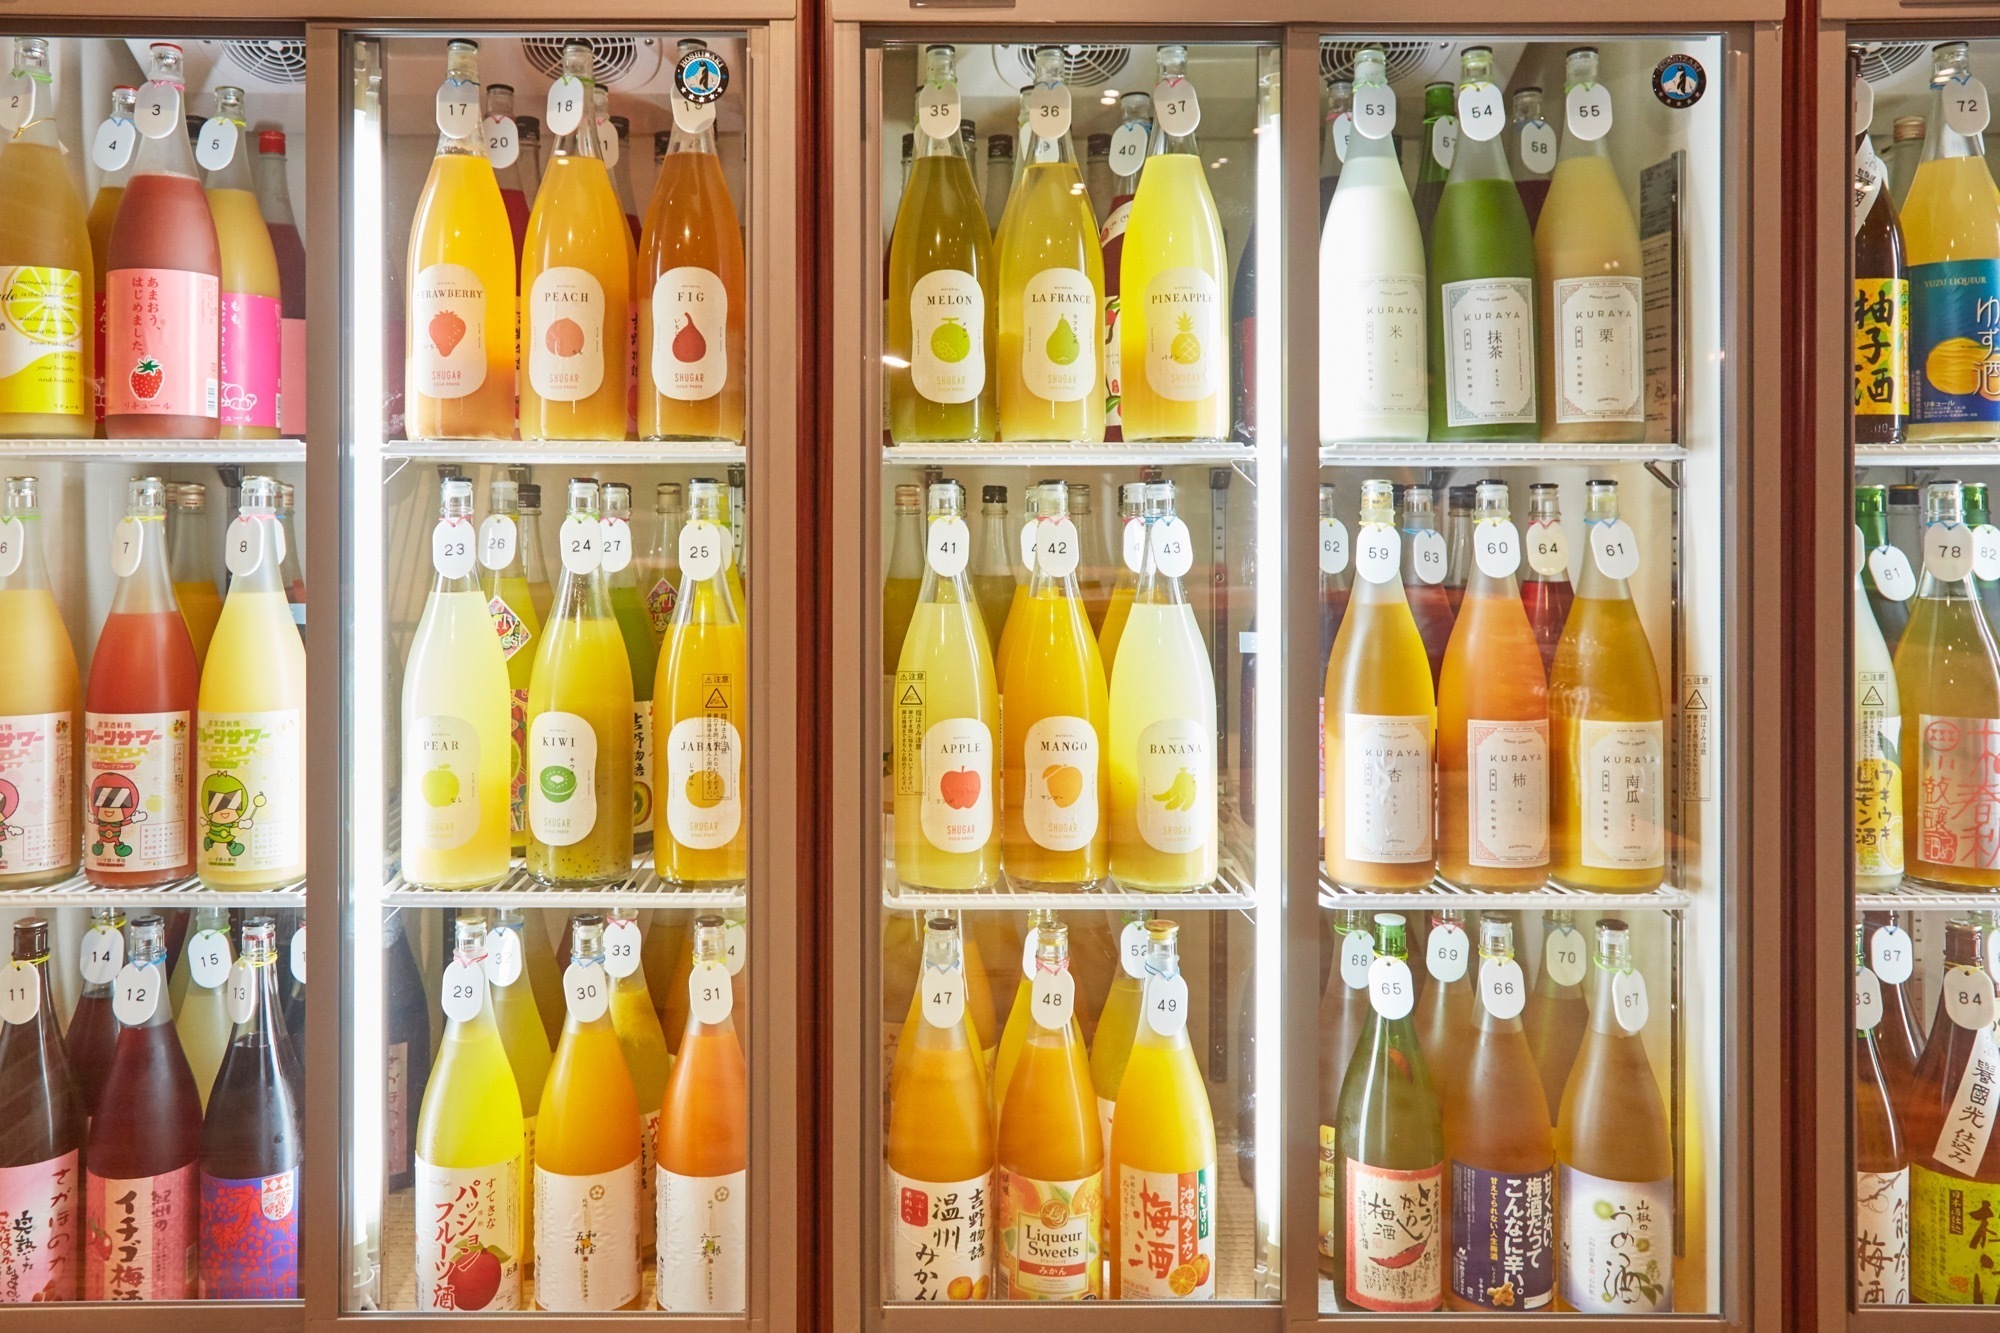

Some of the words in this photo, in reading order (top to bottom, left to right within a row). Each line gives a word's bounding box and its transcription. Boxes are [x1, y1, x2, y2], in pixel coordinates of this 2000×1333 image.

[11, 97, 18, 107] 2
[556, 100, 573, 113] 18
[1167, 101, 1187, 115] 37
[1956, 100, 1977, 112] 72
[152, 104, 160, 116] 3
[448, 103, 467, 116] 17
[930, 105, 949, 117] 35
[1040, 106, 1059, 117] 36
[1366, 104, 1385, 116] 53
[1472, 106, 1493, 119] 54
[1579, 105, 1600, 117] 55
[109, 140, 117, 150] 4
[211, 139, 219, 150] 5
[490, 137, 508, 149] 20
[1532, 141, 1547, 154] 58
[1119, 145, 1136, 156] 40
[1924, 278, 1947, 288] YUZU
[1949, 276, 1987, 286] LIQUEUR
[417, 290, 484, 299] TRAWBERRY
[545, 292, 589, 303] PEACH
[677, 291, 704, 302] FIG
[927, 294, 973, 306] MELON
[1032, 293, 1047, 303] LA
[1050, 292, 1091, 305] FRANCE
[132, 277, 144, 355] はじめました。
[1367, 306, 1418, 315] KURAYA
[1464, 311, 1520, 322] KURAYA
[1575, 310, 1632, 319] KURAYA
[1389, 325, 1403, 339] 米
[1599, 328, 1614, 342] 栗
[1487, 330, 1503, 360] 抹茶
[432, 370, 462, 381] SHUGAR
[549, 373, 579, 384] SHUGAR
[674, 373, 704, 383] SHUGAR
[936, 376, 966, 385] SHUGAR
[1048, 374, 1077, 384] SHUGAR
[0, 542, 7, 551] 6
[123, 542, 129, 554] 7
[239, 541, 247, 553] 8
[445, 543, 465, 556] 23
[488, 538, 505, 550] 26
[572, 539, 591, 552] 24
[604, 541, 621, 552] 27
[940, 542, 956, 554] 41
[1048, 542, 1067, 554] 42
[1163, 542, 1181, 555] 43
[1324, 541, 1340, 553] 62
[1487, 542, 1508, 554] 60
[1539, 543, 1558, 555] 64
[1606, 543, 1624, 556] 61
[690, 546, 709, 559] 25
[1369, 547, 1388, 560] 59
[1424, 551, 1439, 563] 63
[1938, 545, 1961, 558] 78
[1981, 547, 1996, 560] 82
[1884, 568, 1900, 580] 81
[713, 675, 729, 683] 注意
[908, 672, 924, 681] 注意
[1693, 676, 1710, 685] 注意
[1870, 673, 1886, 681] 注意
[424, 741, 459, 751] PEAR
[543, 737, 575, 747] KIWI
[941, 742, 981, 754] APPLE
[1041, 741, 1088, 752] MANGO
[1150, 743, 1202, 754] BANANA
[1366, 749, 1421, 757] KURAYA
[1490, 754, 1542, 762] KURAYA
[1603, 756, 1655, 764] KURAYA
[1388, 768, 1402, 783] 杏
[1512, 773, 1526, 788] 柿
[1626, 775, 1640, 804] 南瓜
[1855, 767, 1876, 846] レモン酒
[1875, 763, 1892, 841] ウキウキ
[544, 817, 571, 827] SHUGAR
[689, 822, 719, 831] SHUGAR
[1048, 822, 1077, 833] SHUGAR
[947, 825, 975, 835] SHUGAR
[1163, 826, 1192, 835] SHUGAR
[612, 945, 631, 956] 33
[1439, 948, 1457, 961] 69
[1884, 950, 1901, 961] 87
[92, 951, 110, 963] 14
[201, 954, 219, 967] 15
[1352, 954, 1367, 966] 68
[1558, 952, 1576, 964] 70
[9, 988, 25, 1000] 11
[127, 988, 146, 1002] 12
[233, 987, 246, 1000] 13
[453, 986, 473, 998] 29
[577, 986, 596, 1000] 30
[703, 988, 720, 1000] 31
[1381, 983, 1401, 995] 65
[1494, 983, 1513, 995] 66
[933, 992, 952, 1005] 47
[1043, 993, 1062, 1006] 48
[1624, 993, 1639, 1008] 67
[1959, 992, 1982, 1005] 84
[1157, 1000, 1177, 1012] 49
[486, 1178, 497, 1229] すてきな
[1198, 1183, 1208, 1235] 生しぼり
[1368, 1193, 1396, 1240] 梅酒
[1490, 1177, 1498, 1261] 甘えてられない人生梅酒
[1637, 1200, 1651, 1231] 山椒の
[455, 1179, 481, 1273] パッション
[968, 1188, 985, 1261] 吉野物語
[1128, 1177, 1179, 1279] 梅酒
[1180, 1184, 1196, 1260] 沖縄タンカン
[1525, 1177, 1542, 1268] 梅酒だって
[1025, 1224, 1082, 1245] Liqueur
[1028, 1241, 1079, 1259] Sweets
[432, 1202, 457, 1311] フルーツ酒
[1039, 1265, 1067, 1276] みかん
